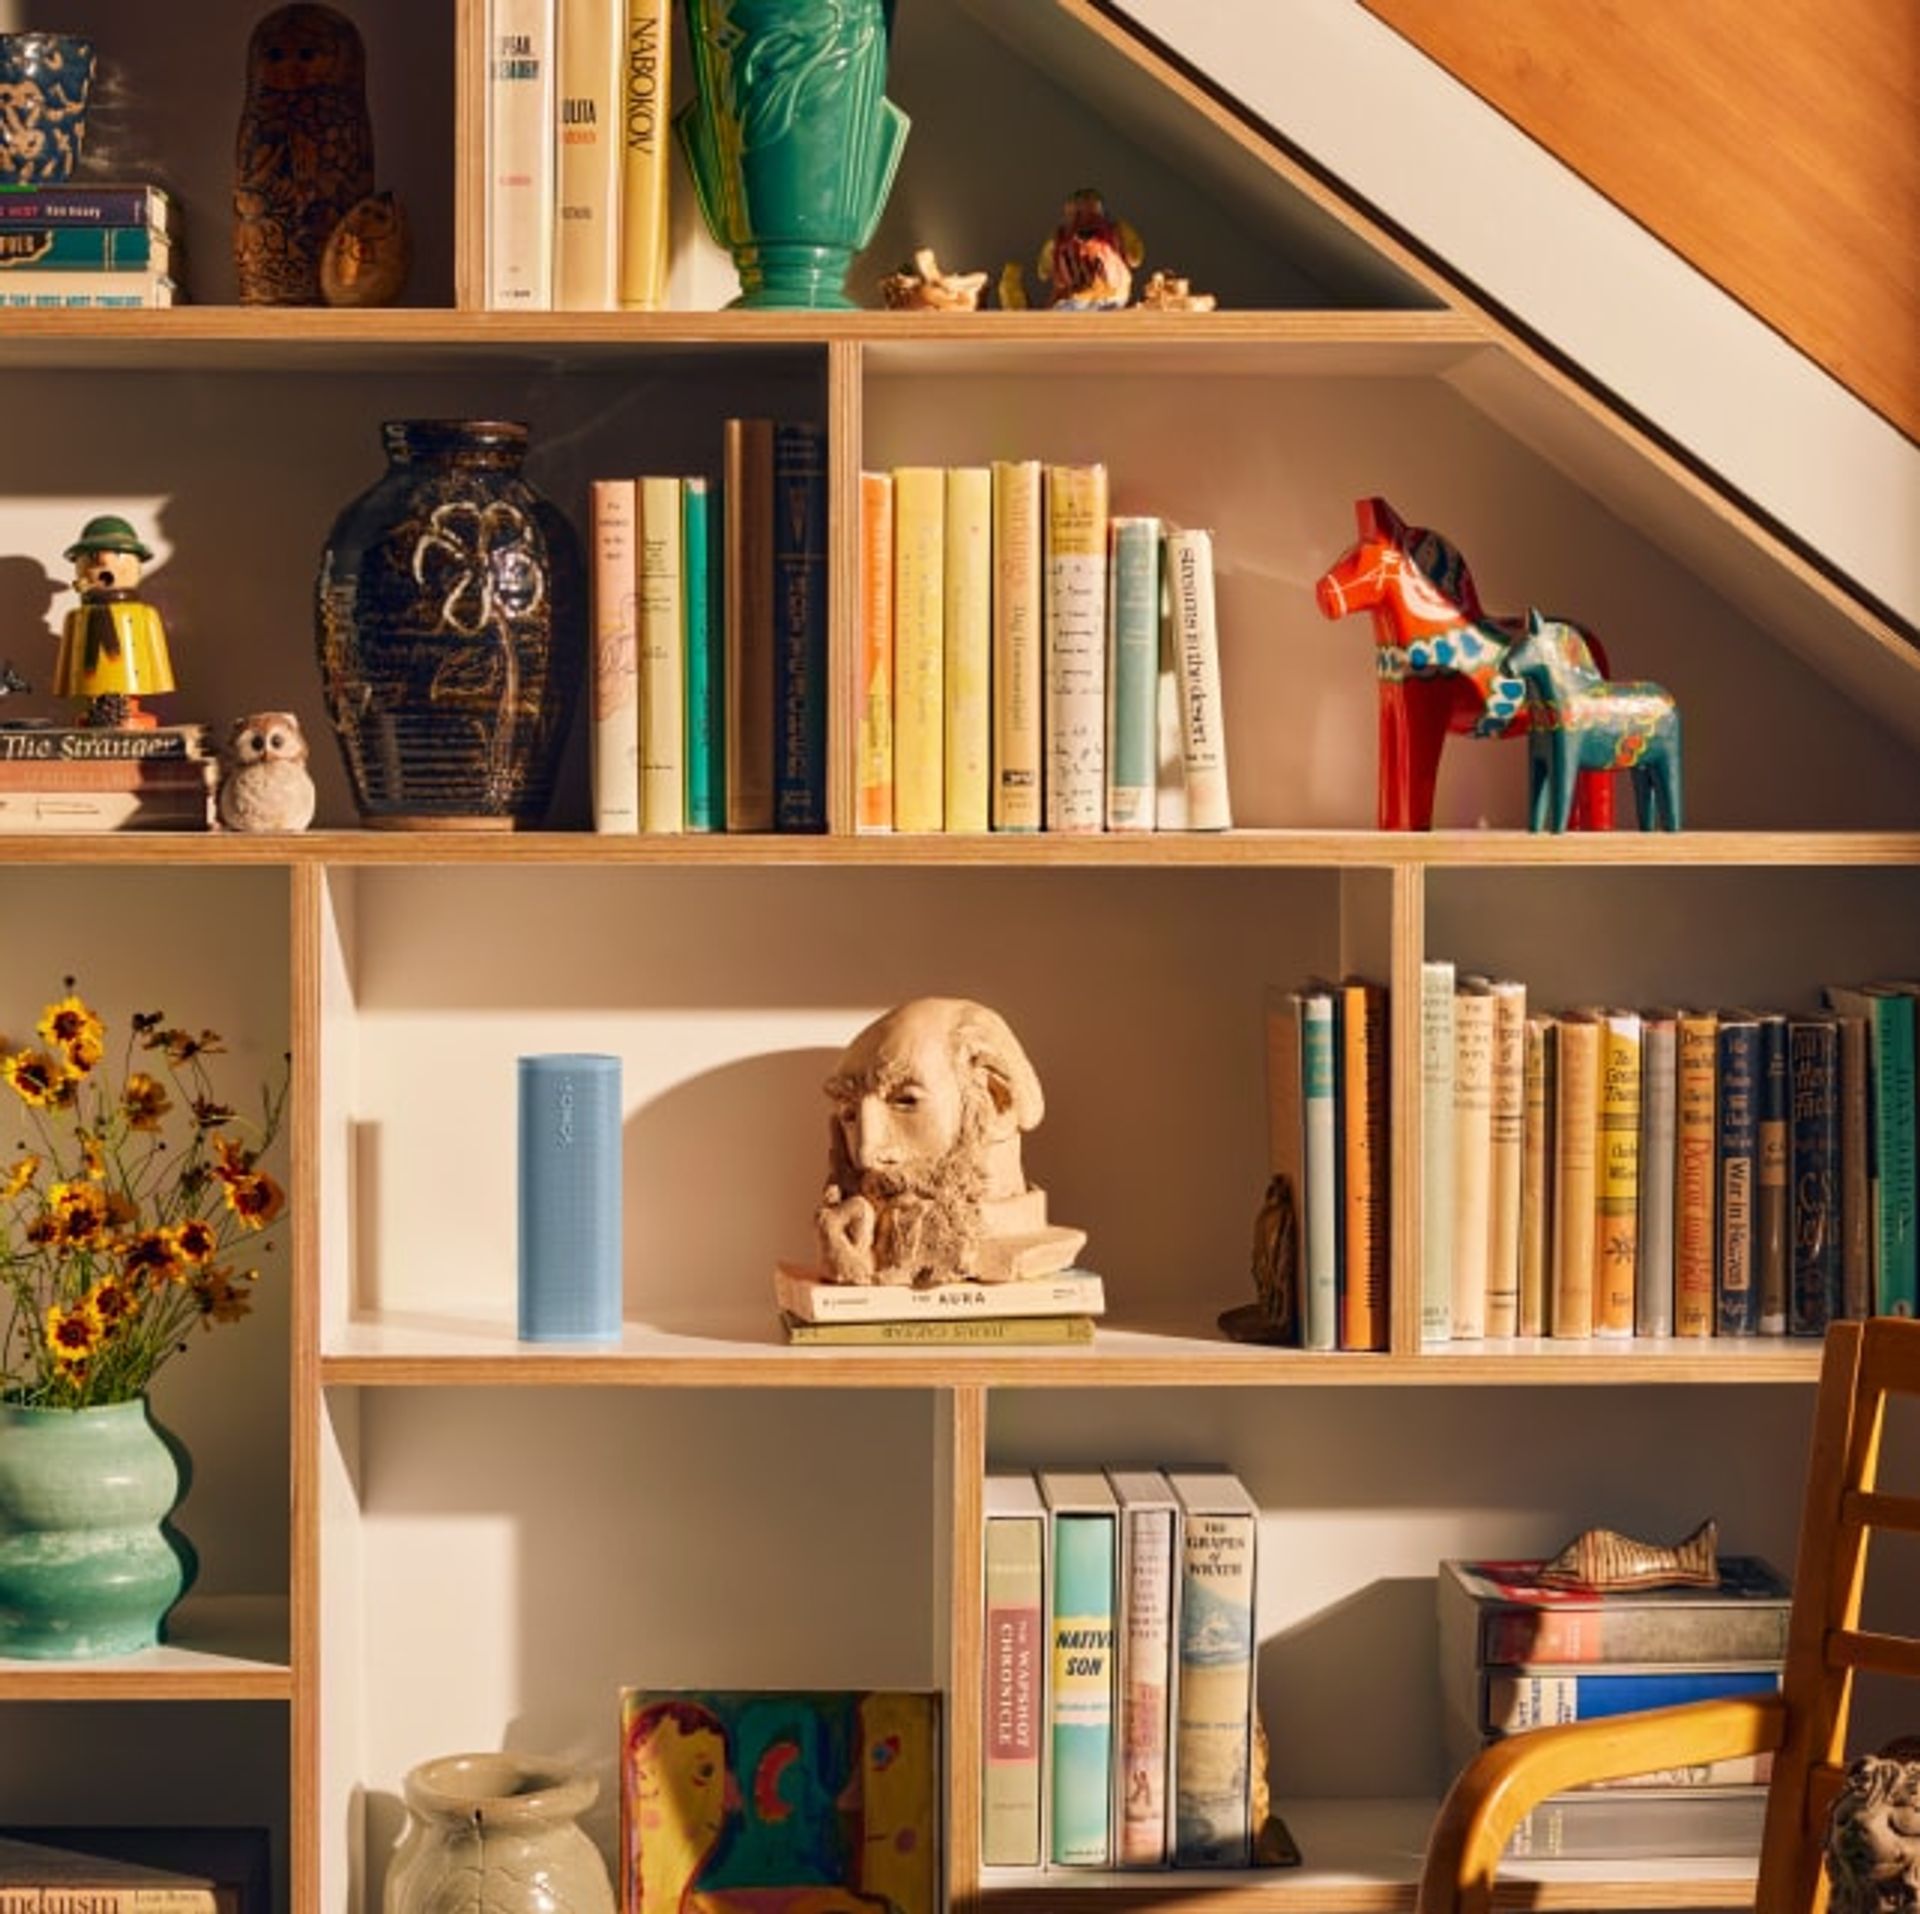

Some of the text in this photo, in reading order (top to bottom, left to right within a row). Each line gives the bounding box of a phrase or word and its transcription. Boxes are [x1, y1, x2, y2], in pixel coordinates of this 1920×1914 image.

[627, 17, 659, 156] NABOKOV
[562, 98, 597, 125] OLITA
[2, 733, 180, 762] The Stranger
[1727, 1160, 1748, 1198] War
[1728, 1202, 1746, 1219] in
[938, 1290, 988, 1305] AURA
[1186, 1536, 1245, 1551] GRAPES
[1188, 1563, 1243, 1578] WRATH
[1055, 1629, 1114, 1651] NATIV
[1065, 1656, 1103, 1677] SON
[998, 1622, 1014, 1747] CHRONICLE
[1016, 1649, 1031, 1748] WAPSHOT
